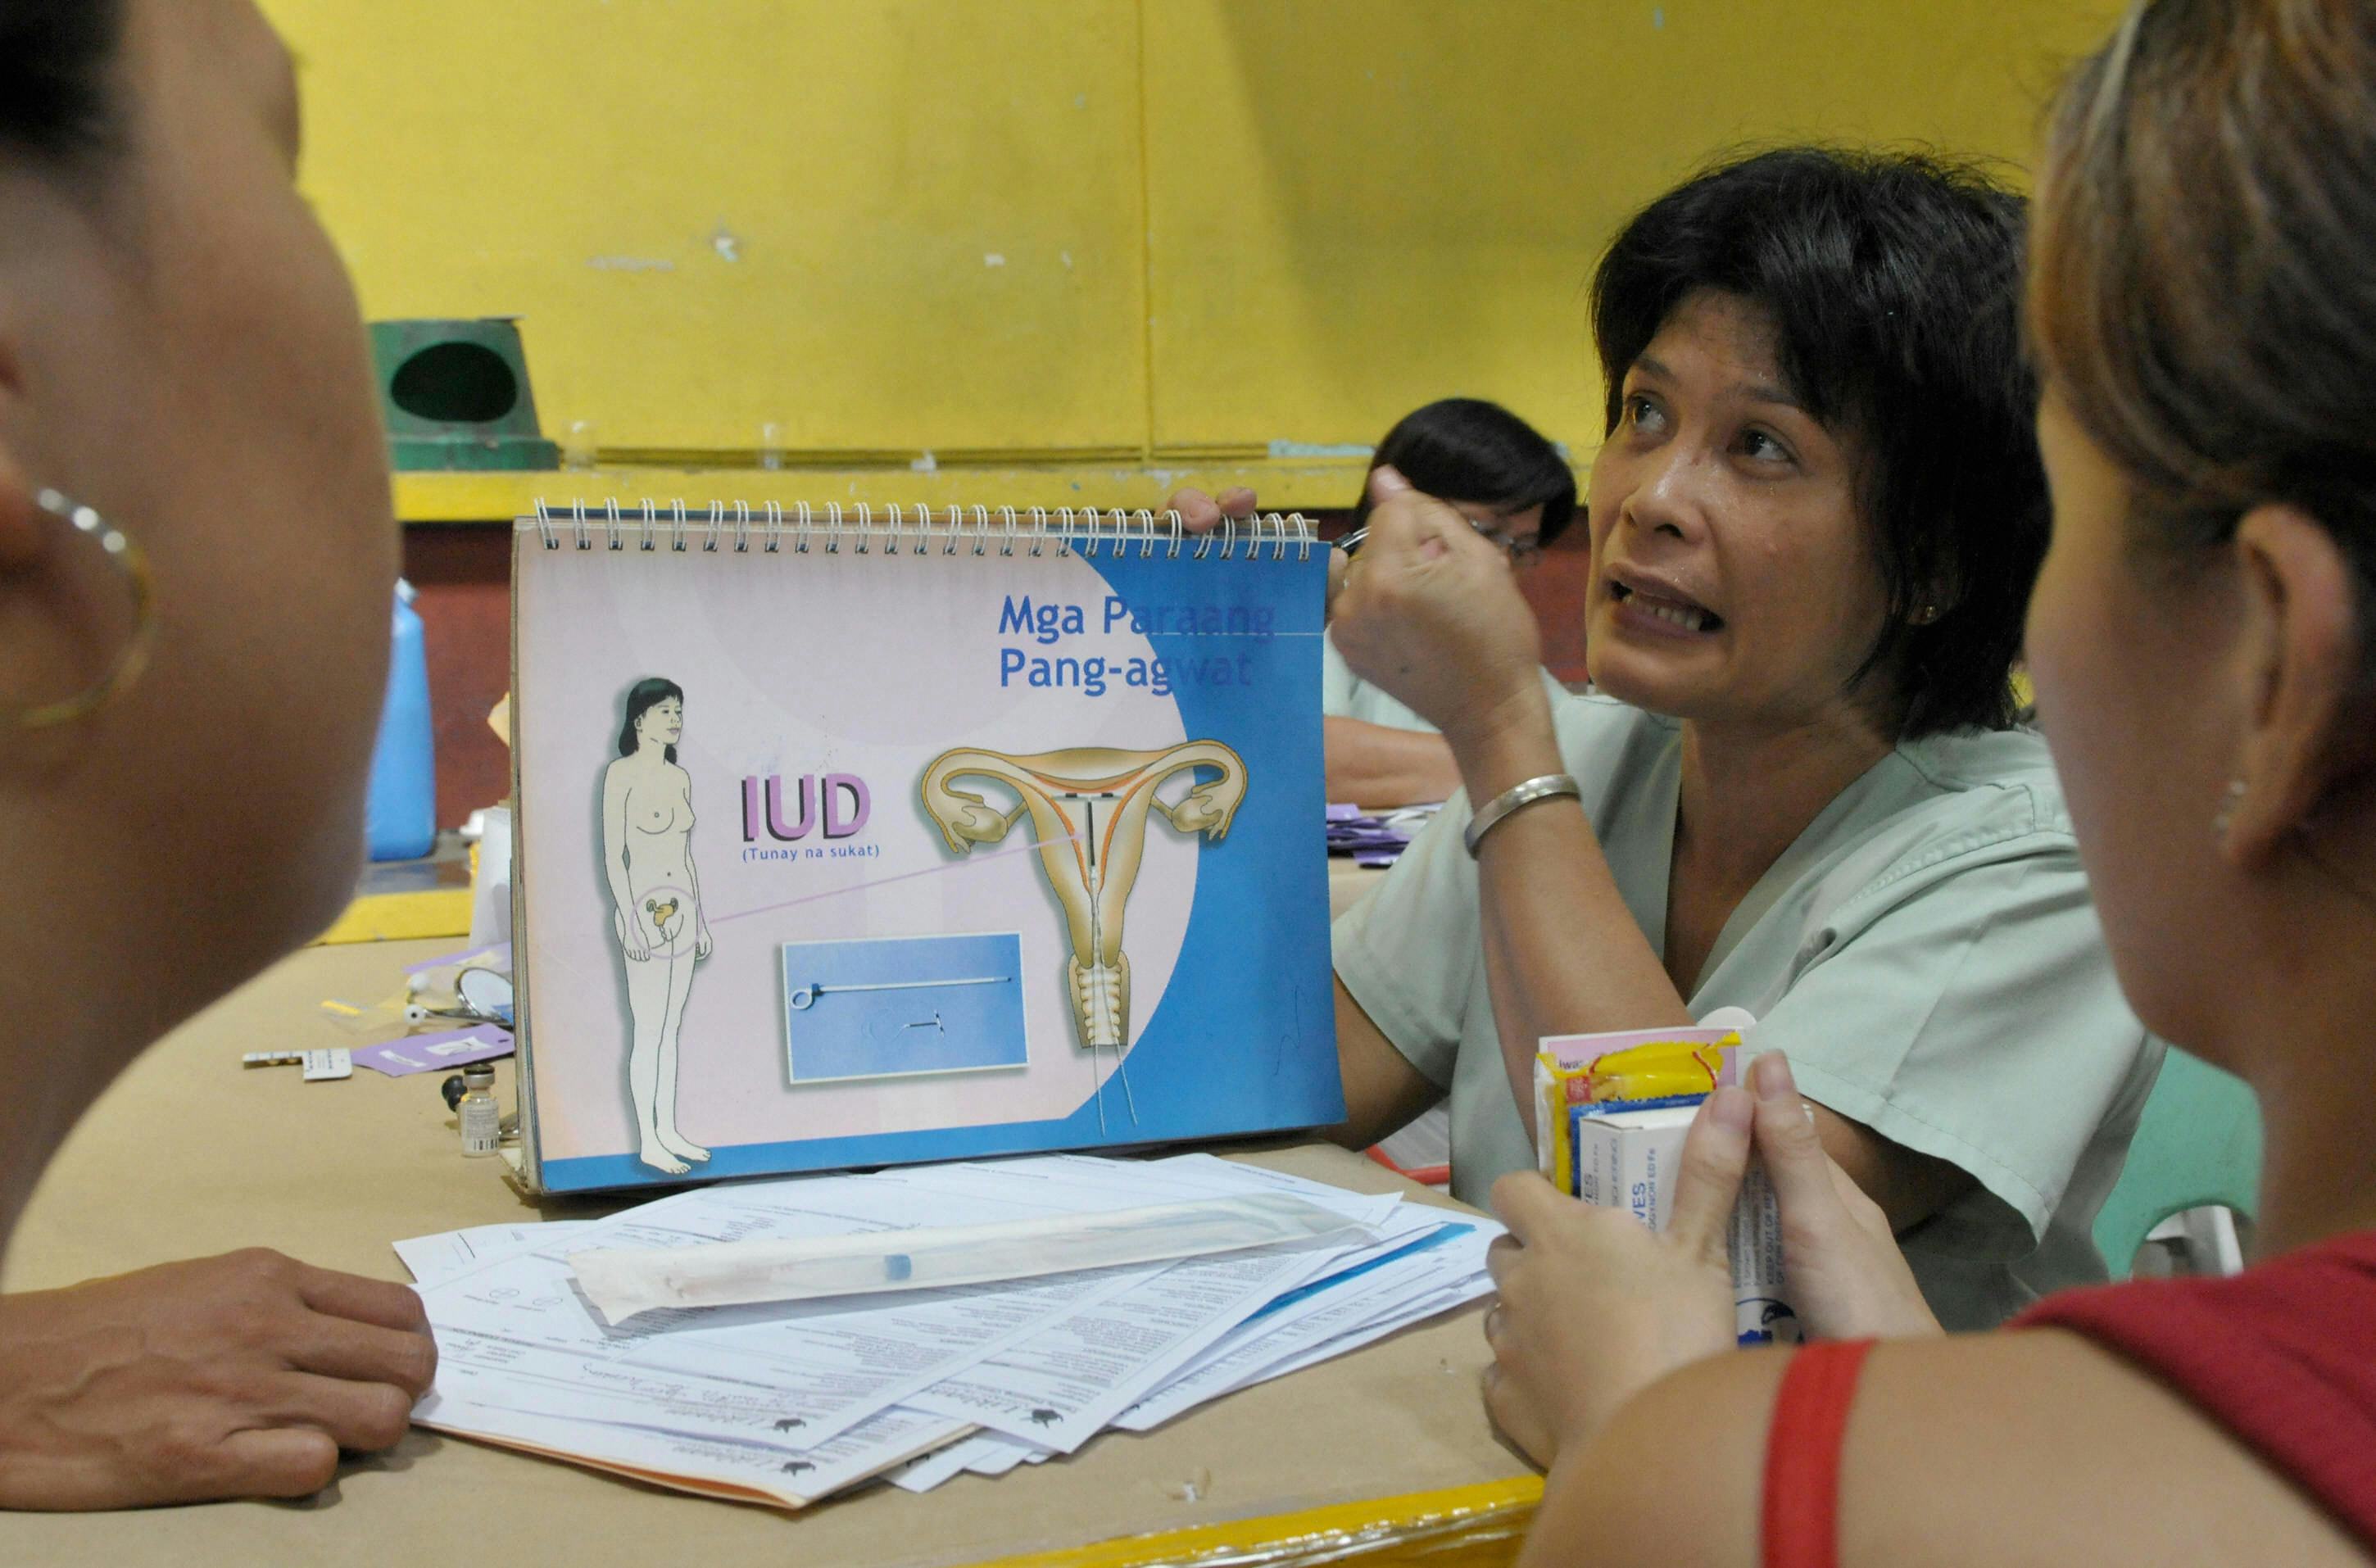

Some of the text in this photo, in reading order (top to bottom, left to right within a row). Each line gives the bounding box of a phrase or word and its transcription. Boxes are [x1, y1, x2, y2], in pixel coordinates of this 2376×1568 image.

[999, 596, 1276, 645] Mga Paraang
[1000, 648, 1254, 696] Pang-agwat
[741, 773, 872, 841] IUD
[742, 845, 879, 863] (Tunay na sukat)
[1632, 1182, 1646, 1219] VES
